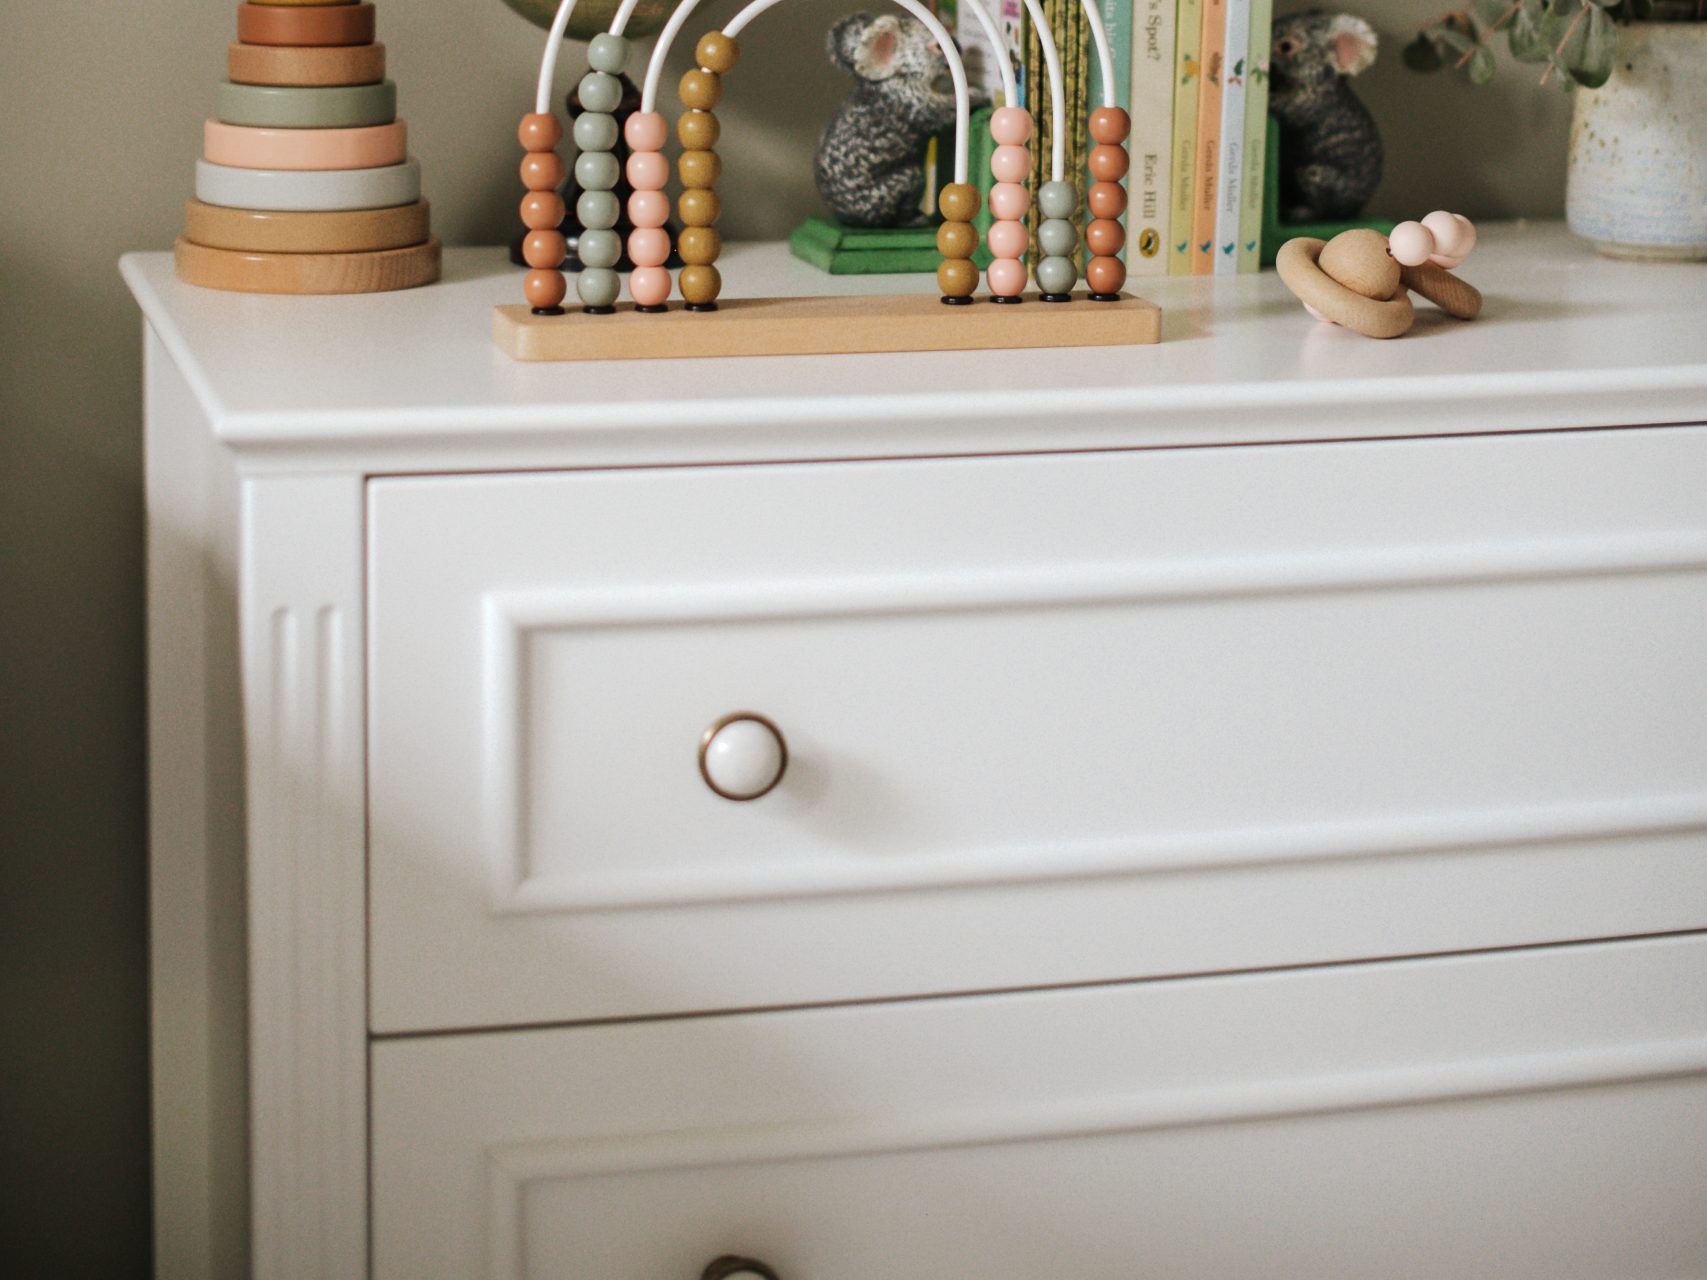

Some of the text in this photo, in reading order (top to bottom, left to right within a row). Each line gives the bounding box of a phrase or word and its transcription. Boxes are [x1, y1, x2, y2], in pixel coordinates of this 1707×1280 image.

[1146, 15, 1161, 60] Spot?
[1205, 141, 1216, 172] Gerda
[1229, 142, 1240, 174] Gerda
[1143, 154, 1157, 218] Eric Hill
